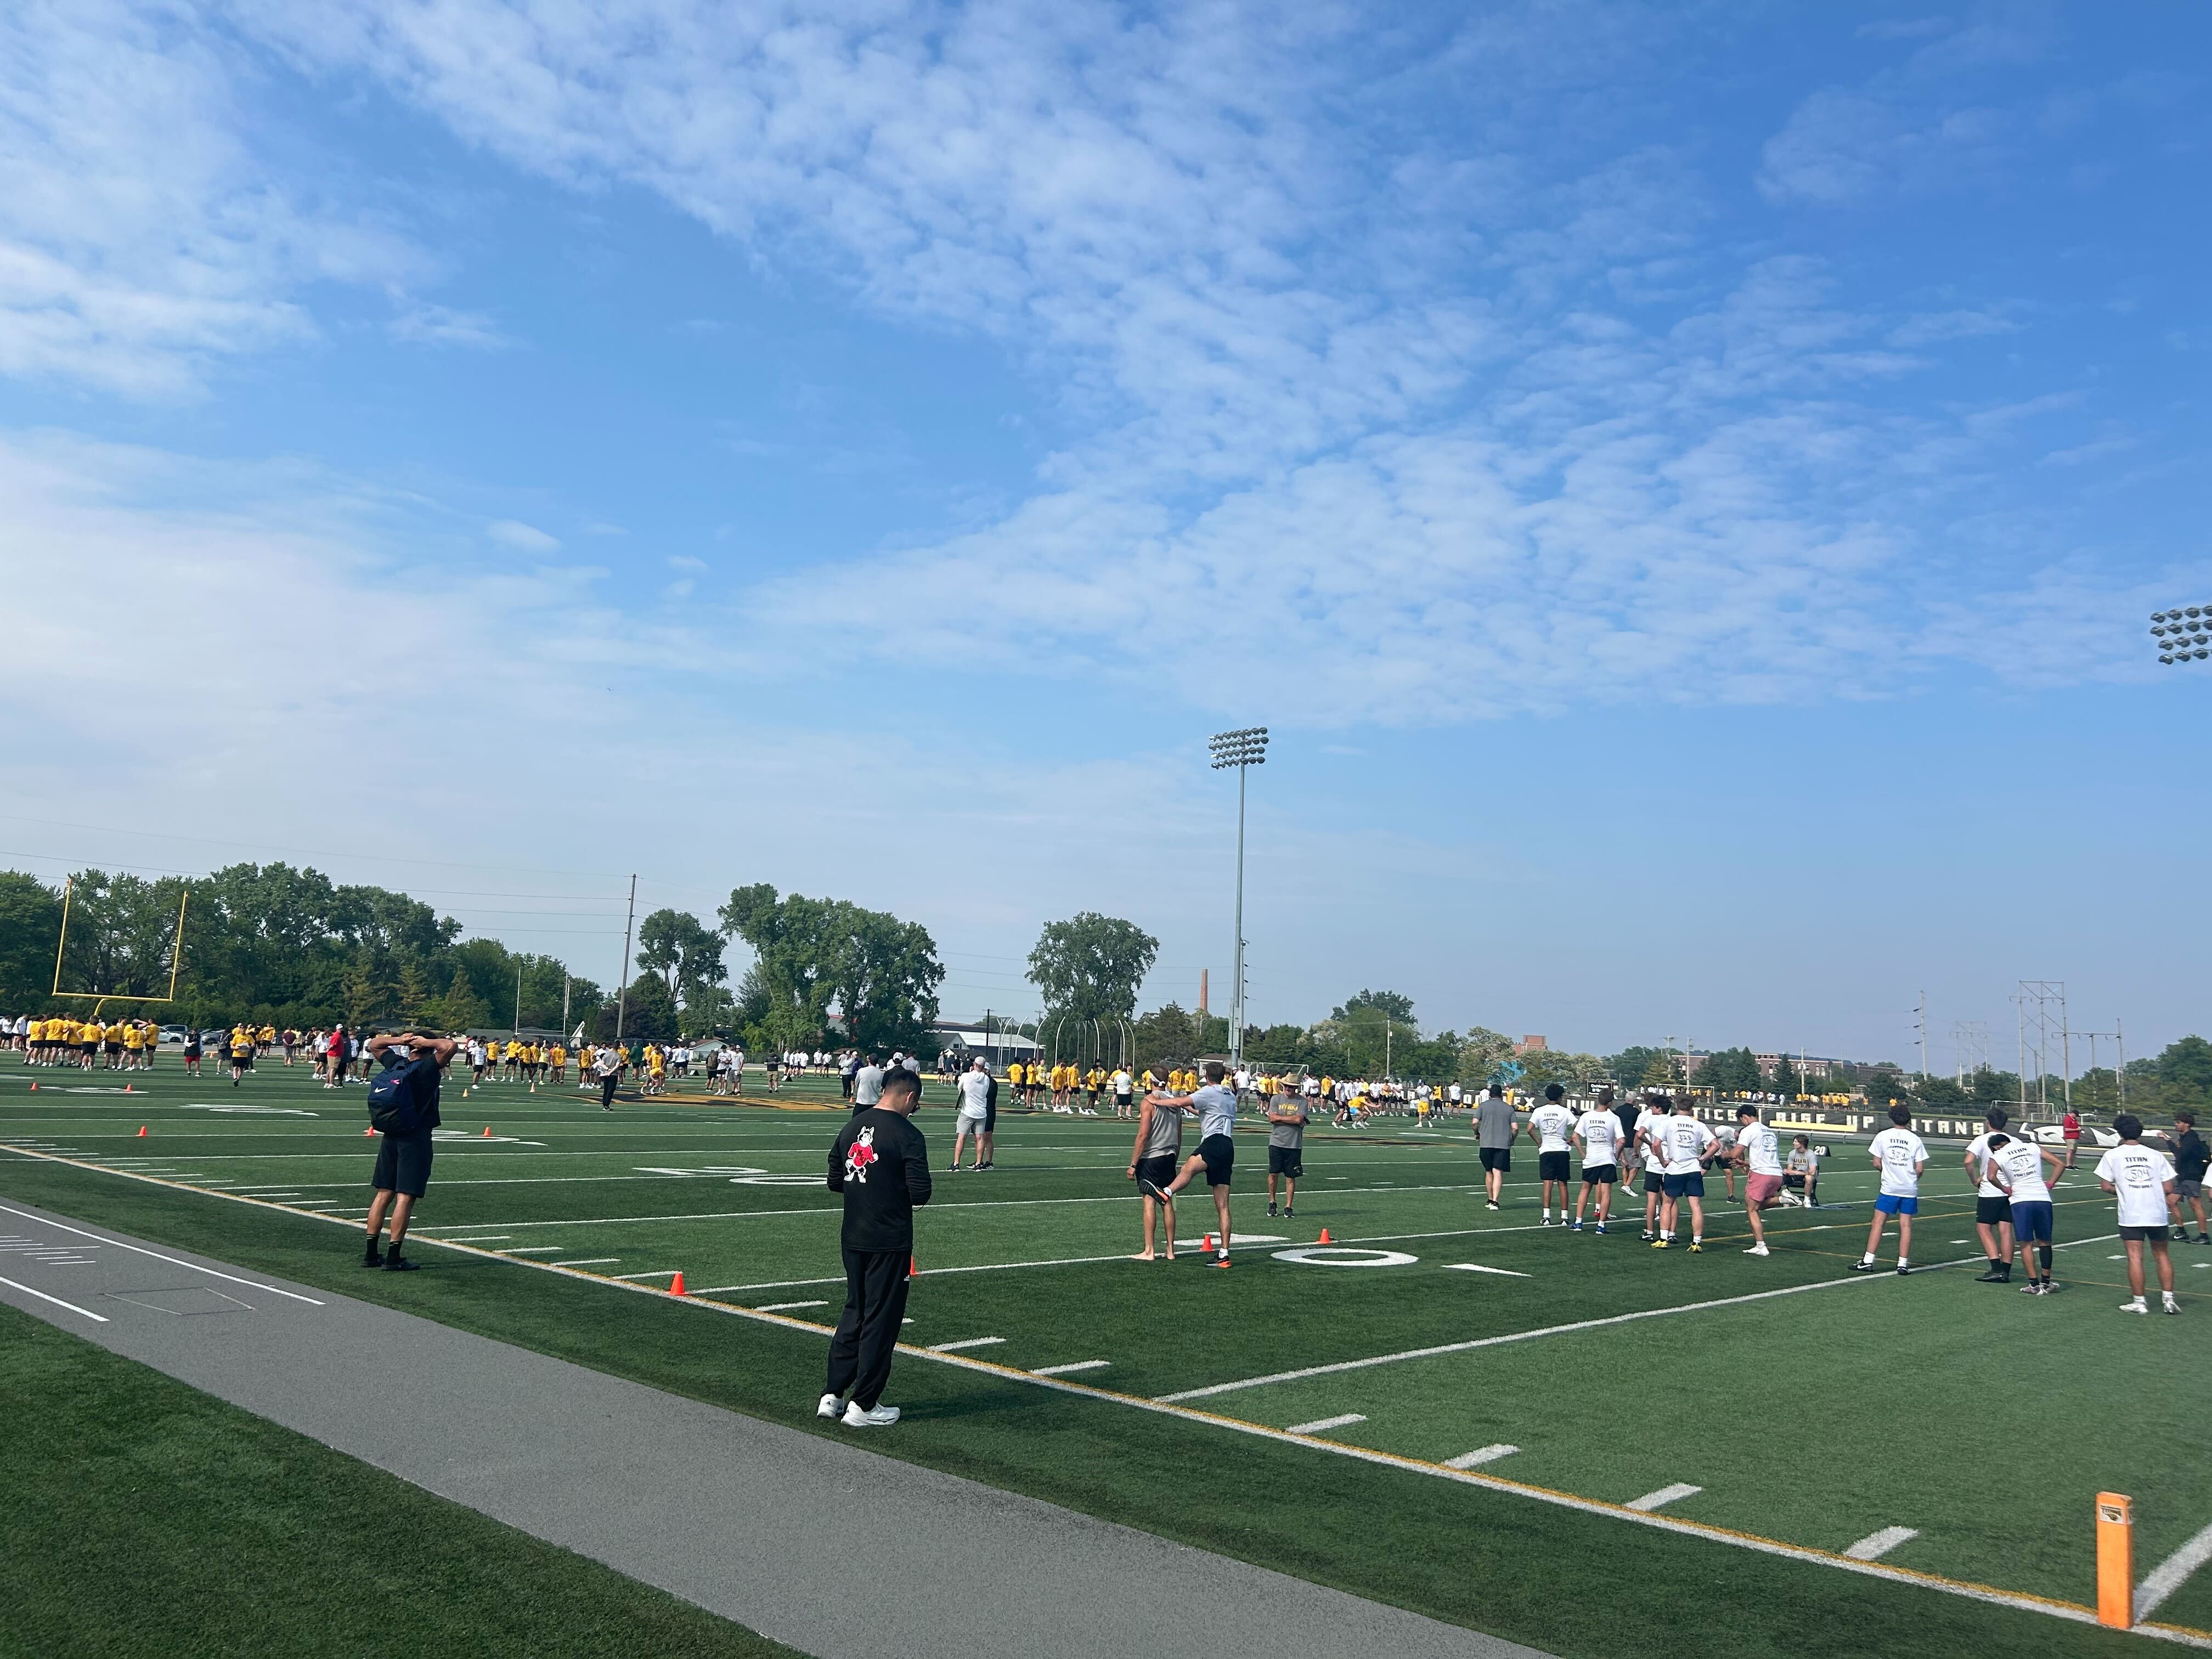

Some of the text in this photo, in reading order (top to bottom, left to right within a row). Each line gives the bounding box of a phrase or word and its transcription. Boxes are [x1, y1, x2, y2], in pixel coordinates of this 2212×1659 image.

[1776, 1111, 1985, 1135] RISE UP ITANS
[1814, 1145, 1826, 1155] 20
[2007, 1147, 2028, 1155] TITAN
[2013, 1158, 2029, 1169] 503
[2130, 1169, 2150, 1180] 504
